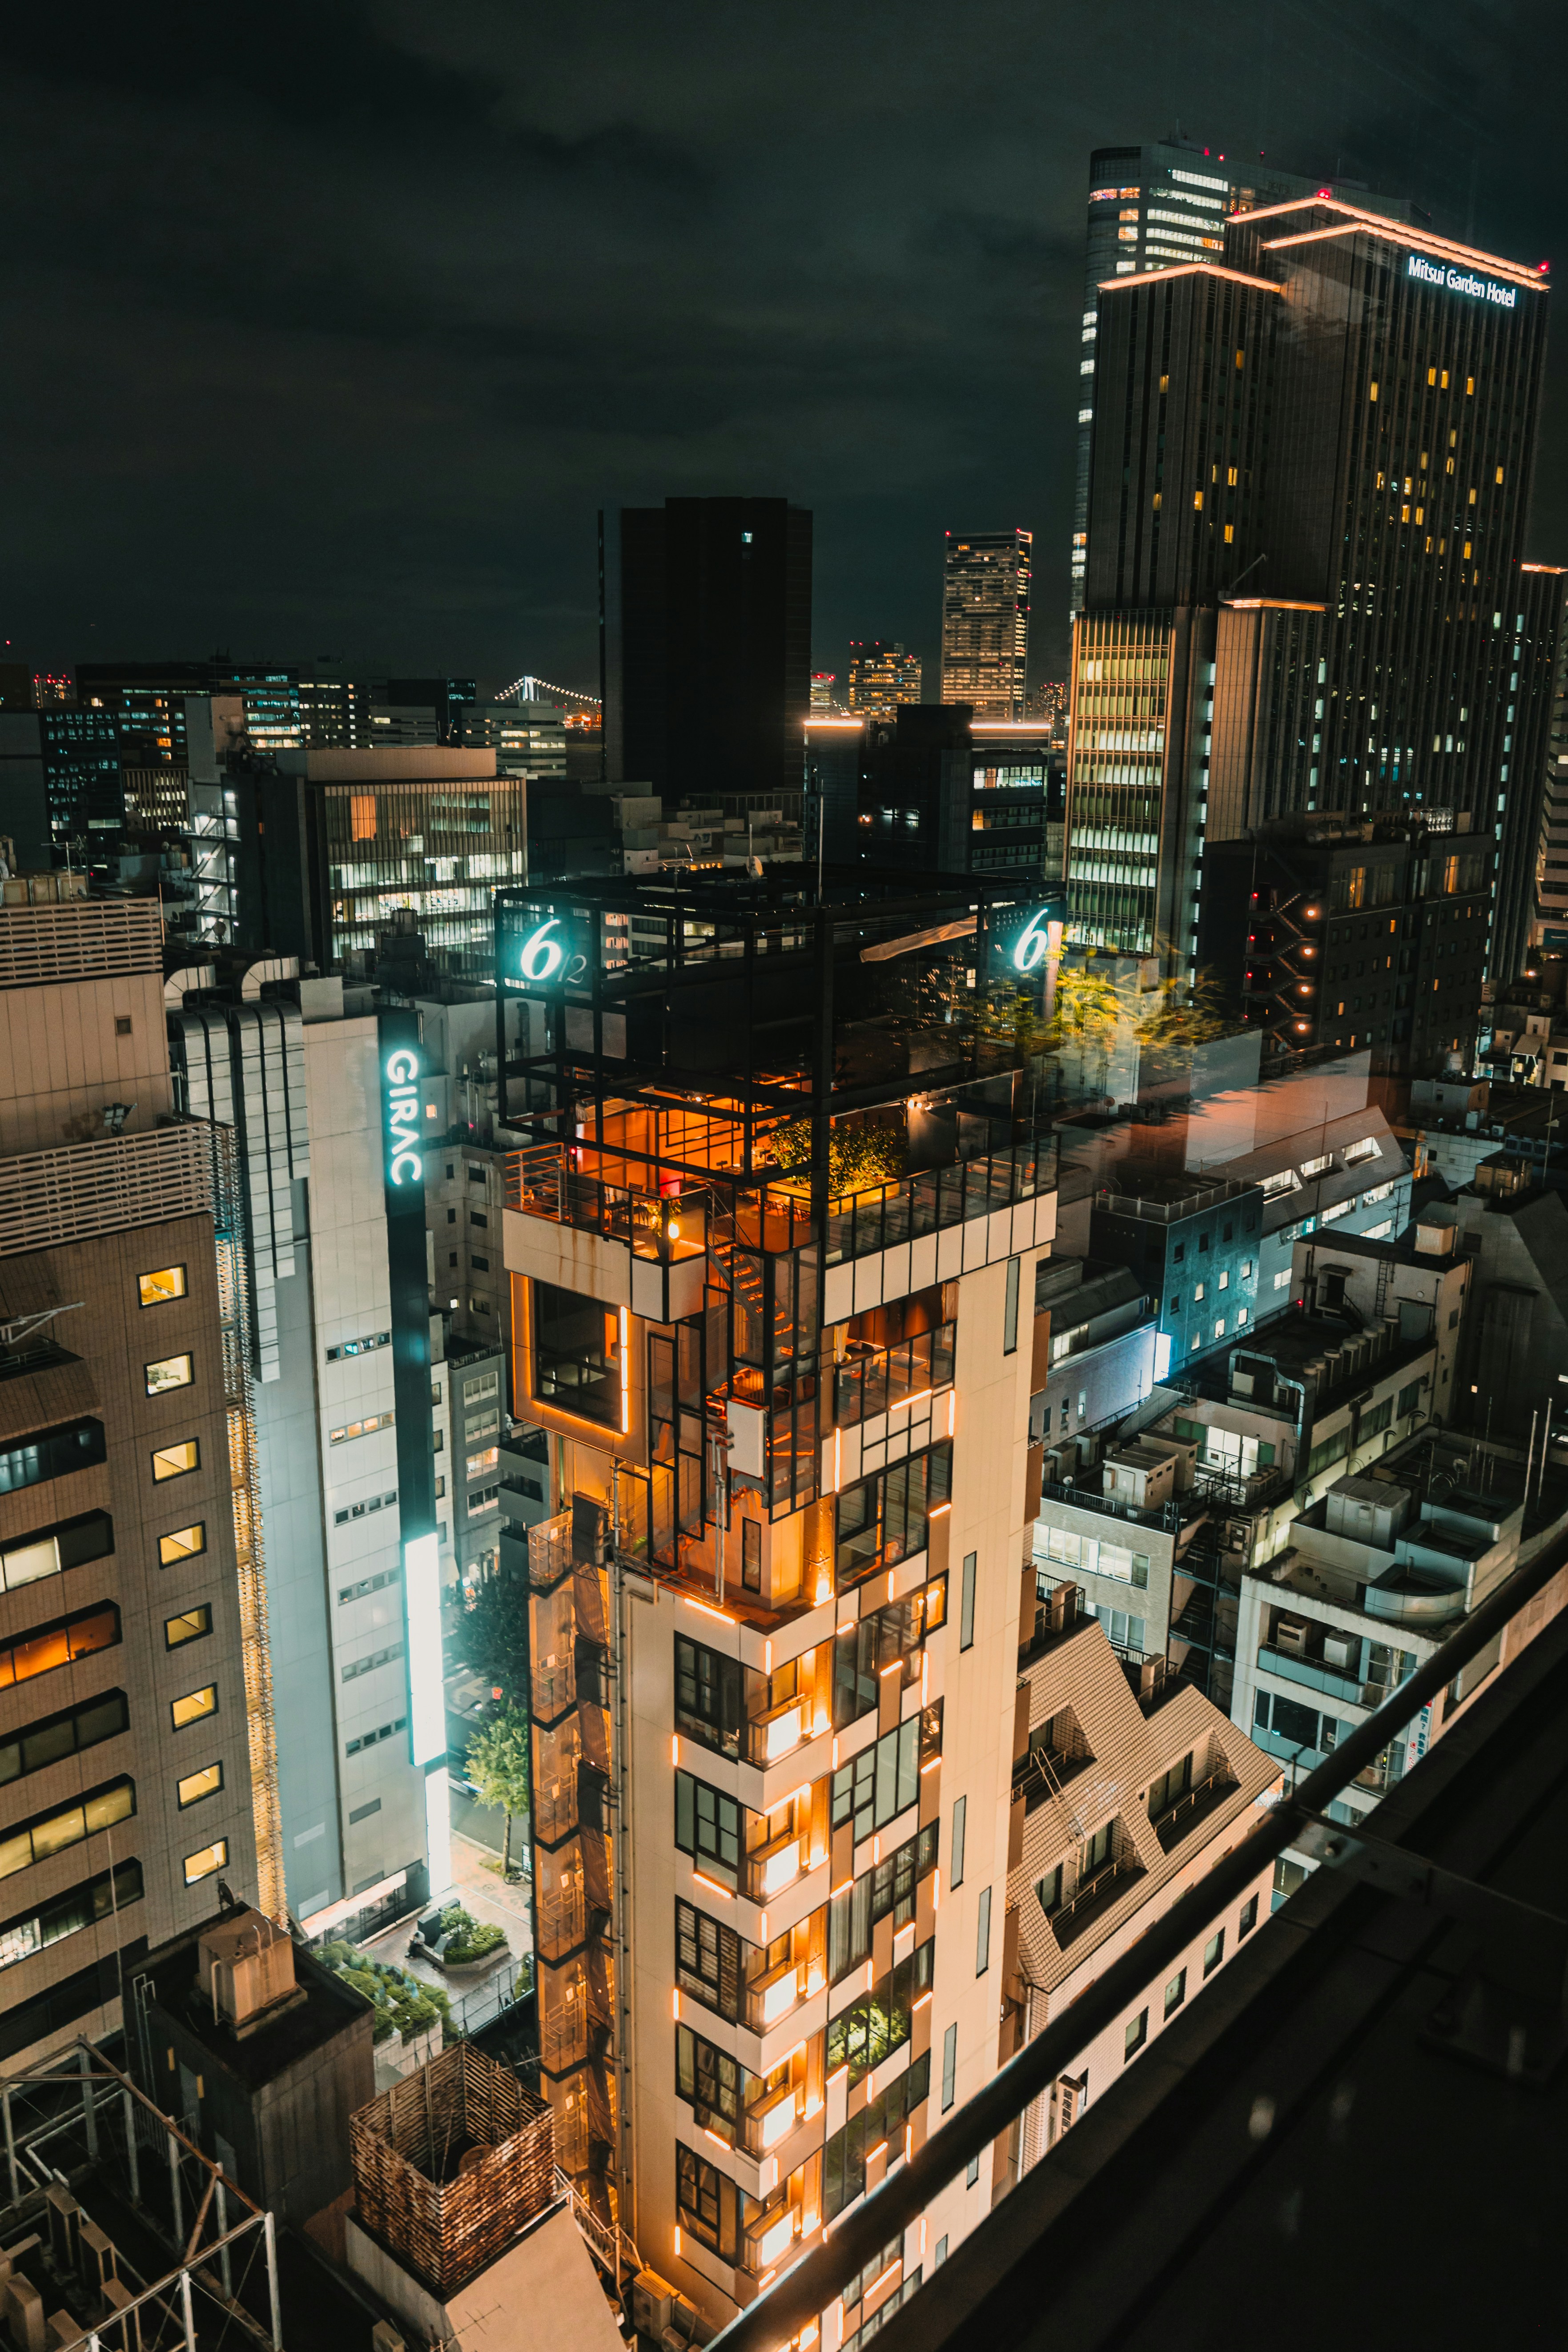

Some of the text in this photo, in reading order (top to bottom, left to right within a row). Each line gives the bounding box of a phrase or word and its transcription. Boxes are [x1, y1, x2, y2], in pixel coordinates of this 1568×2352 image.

[1408, 256, 1516, 308] Mitsui Garden Hotel
